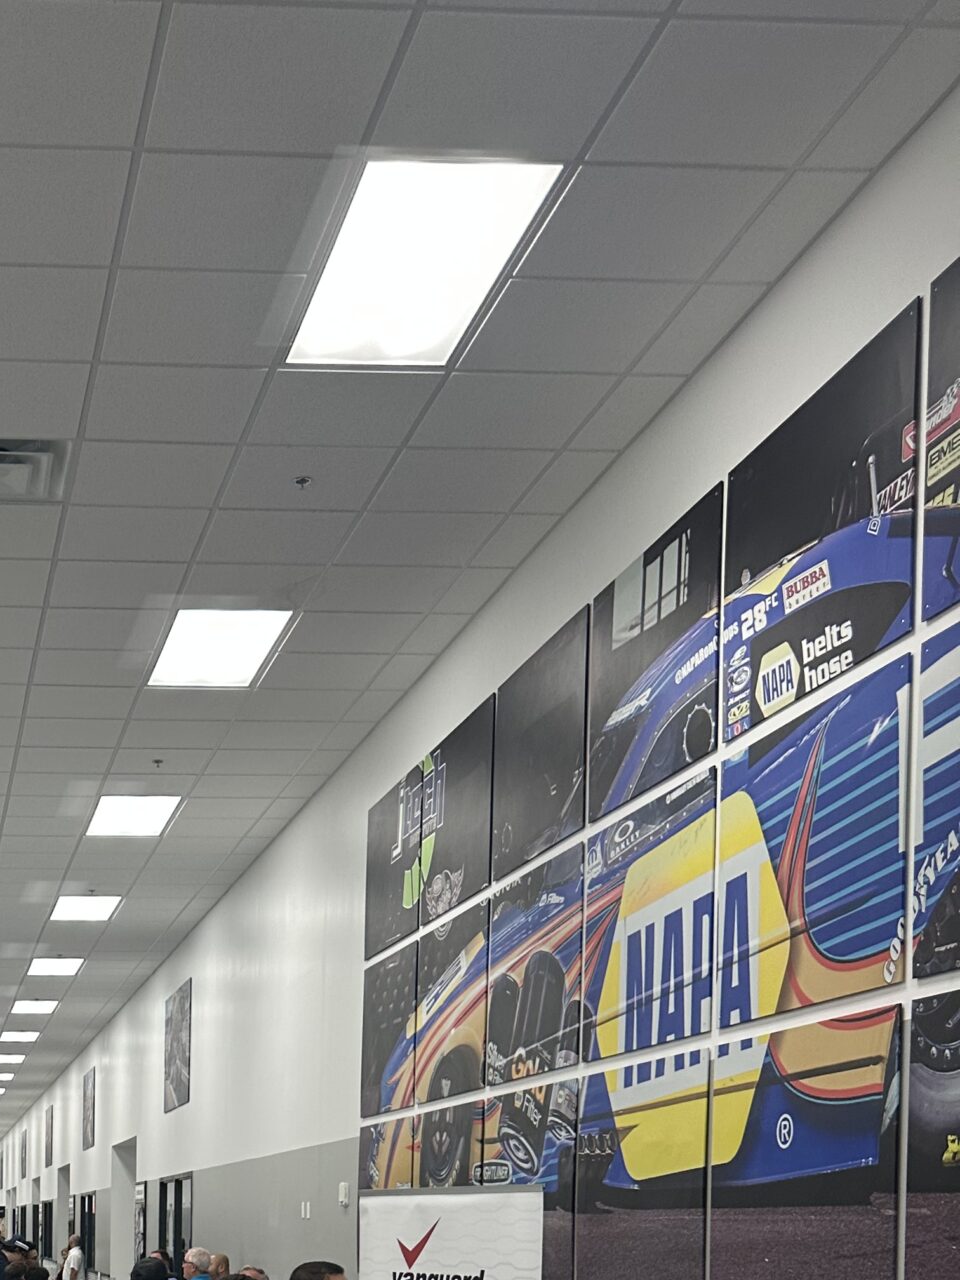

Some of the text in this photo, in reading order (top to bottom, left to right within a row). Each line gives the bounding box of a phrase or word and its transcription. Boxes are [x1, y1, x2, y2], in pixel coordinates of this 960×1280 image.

[785, 566, 827, 599] BUBBA
[801, 619, 853, 665] belts
[762, 659, 795, 705] NAPA
[803, 650, 854, 693] hose
[610, 830, 641, 859] OAKLEY
[623, 872, 753, 1089] NAPA
